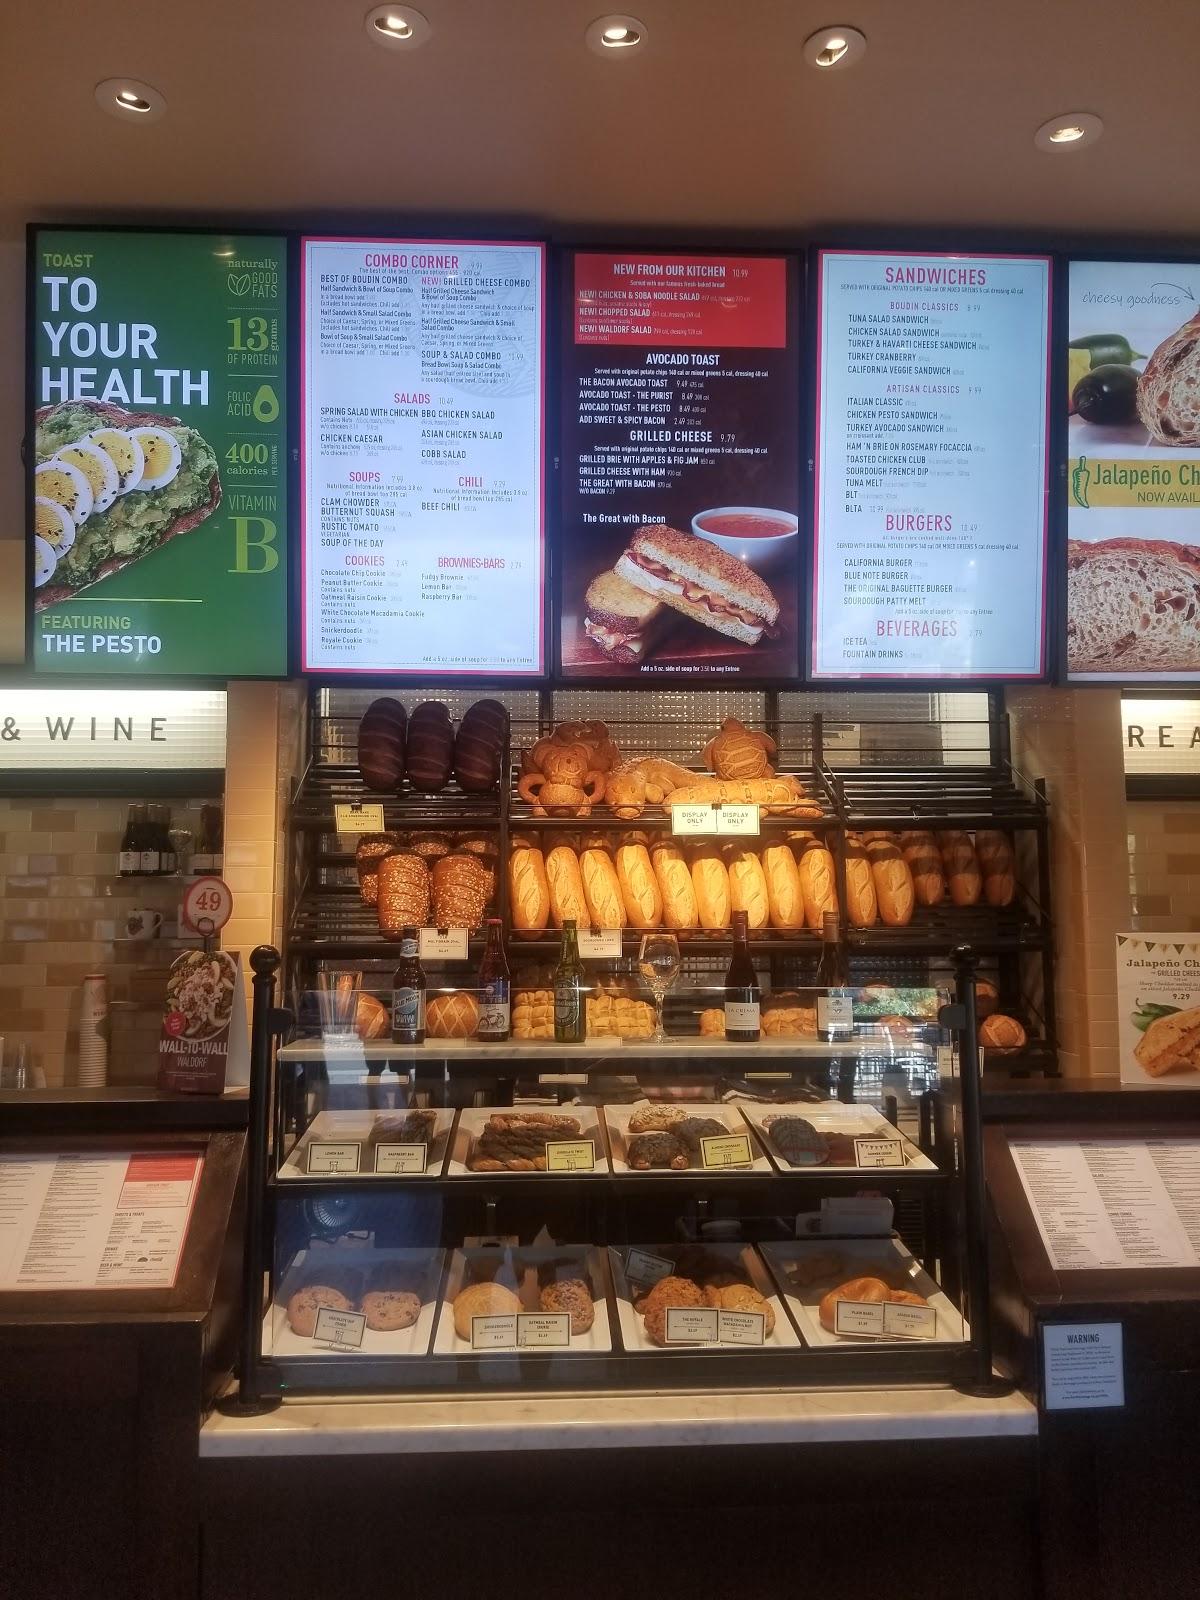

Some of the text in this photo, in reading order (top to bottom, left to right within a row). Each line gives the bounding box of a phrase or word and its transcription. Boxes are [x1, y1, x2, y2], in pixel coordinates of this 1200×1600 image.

[43, 254, 94, 268] TOAST
[228, 258, 278, 270] naturally
[366, 254, 459, 269] COMBO CORNER
[614, 264, 635, 275] NEW
[638, 264, 663, 275] FROM
[665, 265, 684, 276] OUR
[687, 266, 726, 277] KITCHEN
[886, 267, 986, 285] SANDWICHES
[252, 272, 278, 285] GOOD
[320, 274, 408, 284] BEST OF BOUDIN COMBO
[444, 277, 473, 286] GRILLED
[476, 278, 502, 287] CHEESE
[504, 279, 530, 287] COMBO
[42, 276, 98, 312] TO
[252, 284, 278, 298] FATS
[1082, 292, 1180, 309] cheesy goodness
[580, 307, 597, 316] NEW!
[598, 308, 628, 316] CHOPPED
[890, 302, 959, 311] BOUDIN CLASSICS
[849, 314, 928, 324] TUNA SALAD SANDWICH
[226, 316, 269, 352] 13
[580, 325, 597, 333] NEW!
[599, 325, 630, 333] WALDORF
[42, 321, 158, 359] YOUR
[271, 318, 280, 352] grams
[227, 353, 278, 366] OF PROTEIN
[646, 353, 720, 365] AVOCADO TOAST
[876, 353, 916, 361] CRANBERRY
[848, 365, 887, 374] CALIFORNIA
[914, 367, 951, 375] SANDWICH
[42, 366, 209, 406] HEALTH
[886, 385, 960, 393] ARTISAN CLASSICS
[227, 391, 251, 402] FOLIC
[394, 393, 430, 404] SALADS
[848, 398, 903, 406] ITALIAN CLASSIC
[227, 403, 251, 416] ACID
[320, 407, 419, 417] SPRING SALAD WITH CHICKEN
[847, 410, 876, 418] CHICKEN
[901, 411, 938, 420] SANDWICH
[594, 416, 616, 424] SWEET
[320, 434, 383, 443] CHICKEN CAESAR
[421, 430, 503, 440] ASIAN CHICKEN SALAD
[630, 430, 735, 442] GRILLED CHEESE 9.79
[224, 443, 269, 464] 400
[846, 455, 876, 464] TOASTED
[226, 466, 268, 475] calories
[580, 467, 605, 475] GRILLED
[350, 472, 381, 482] SOUPS
[458, 476, 482, 487] CHILI
[1093, 464, 1172, 490] Jalapeño
[846, 479, 864, 487] TUNA
[866, 479, 883, 487] MELT
[320, 498, 380, 507] CLAM CHOWDER
[1137, 492, 1165, 502] NOW
[228, 494, 277, 512] VITAMIN
[321, 507, 395, 517] BUTTERNUT SQUASH
[583, 514, 666, 523] The Great with Bacon
[886, 514, 952, 532] BURGERS
[321, 522, 379, 531] RUSTIC TOMATO
[227, 516, 279, 574] B
[345, 555, 385, 566] COOKIES
[882, 572, 908, 580] BURGER
[41, 616, 132, 630] FEATURING
[877, 620, 957, 637] BEVERAGES
[42, 634, 162, 654] THE PESTO
[1, 716, 167, 742] & WINE
[196, 891, 222, 912] 49
[1126, 960, 1180, 969] Jalapeño
[159, 1040, 228, 1056] WALL-TO-WALL
[177, 1057, 207, 1067] WALDORF
[1067, 1334, 1099, 1344] WARNING
